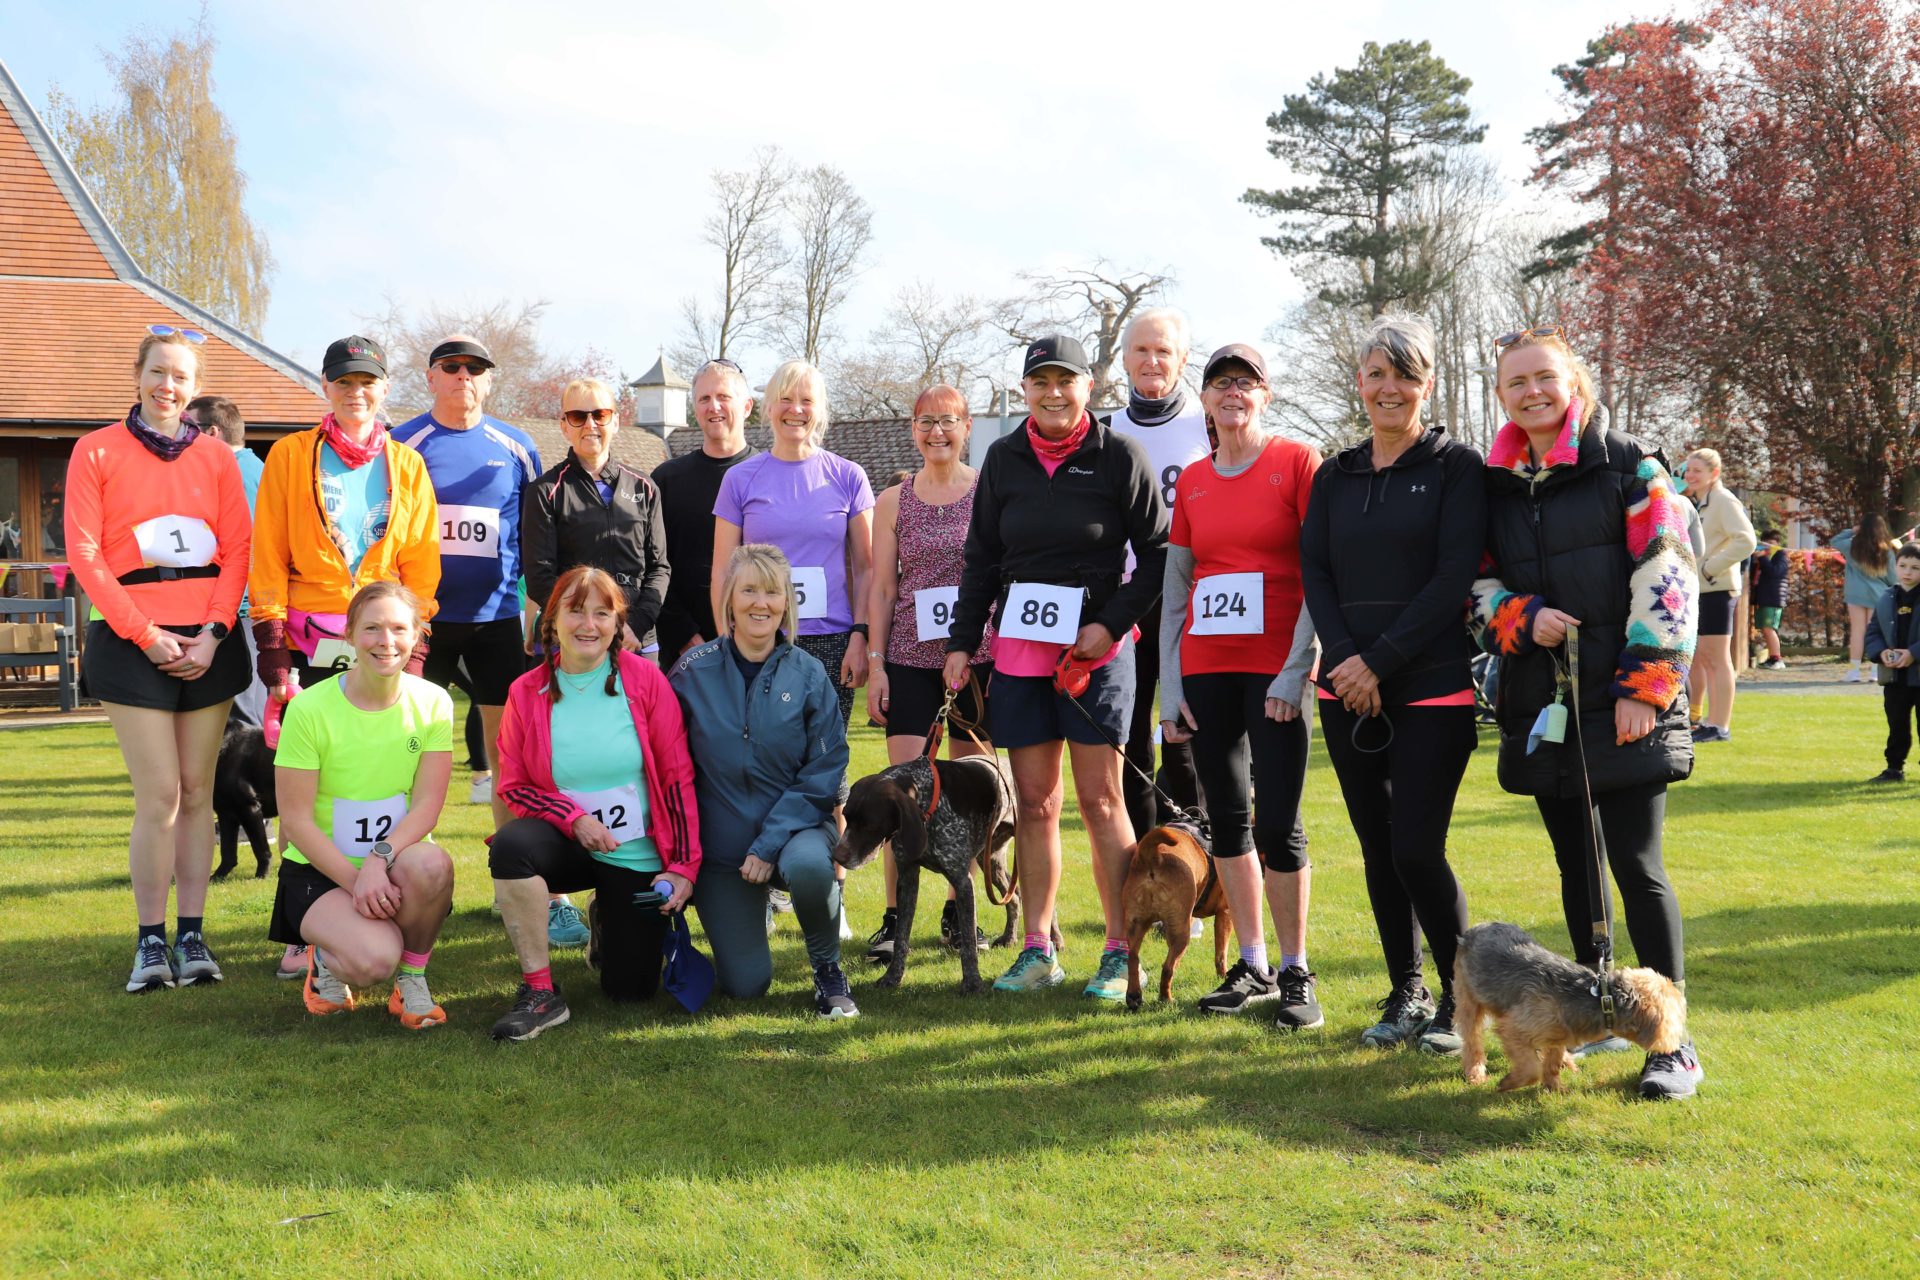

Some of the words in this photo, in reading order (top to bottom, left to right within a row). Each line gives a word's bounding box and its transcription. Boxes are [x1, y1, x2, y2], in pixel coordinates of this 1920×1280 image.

[170, 529, 191, 553] 1
[442, 520, 488, 543] 109
[792, 582, 806, 606] 5
[1202, 592, 1248, 619] 124
[932, 602, 957, 626] 9
[1021, 599, 1060, 628] 86
[331, 654, 359, 670] 6
[354, 814, 393, 843] 12
[592, 804, 628, 830] 12
